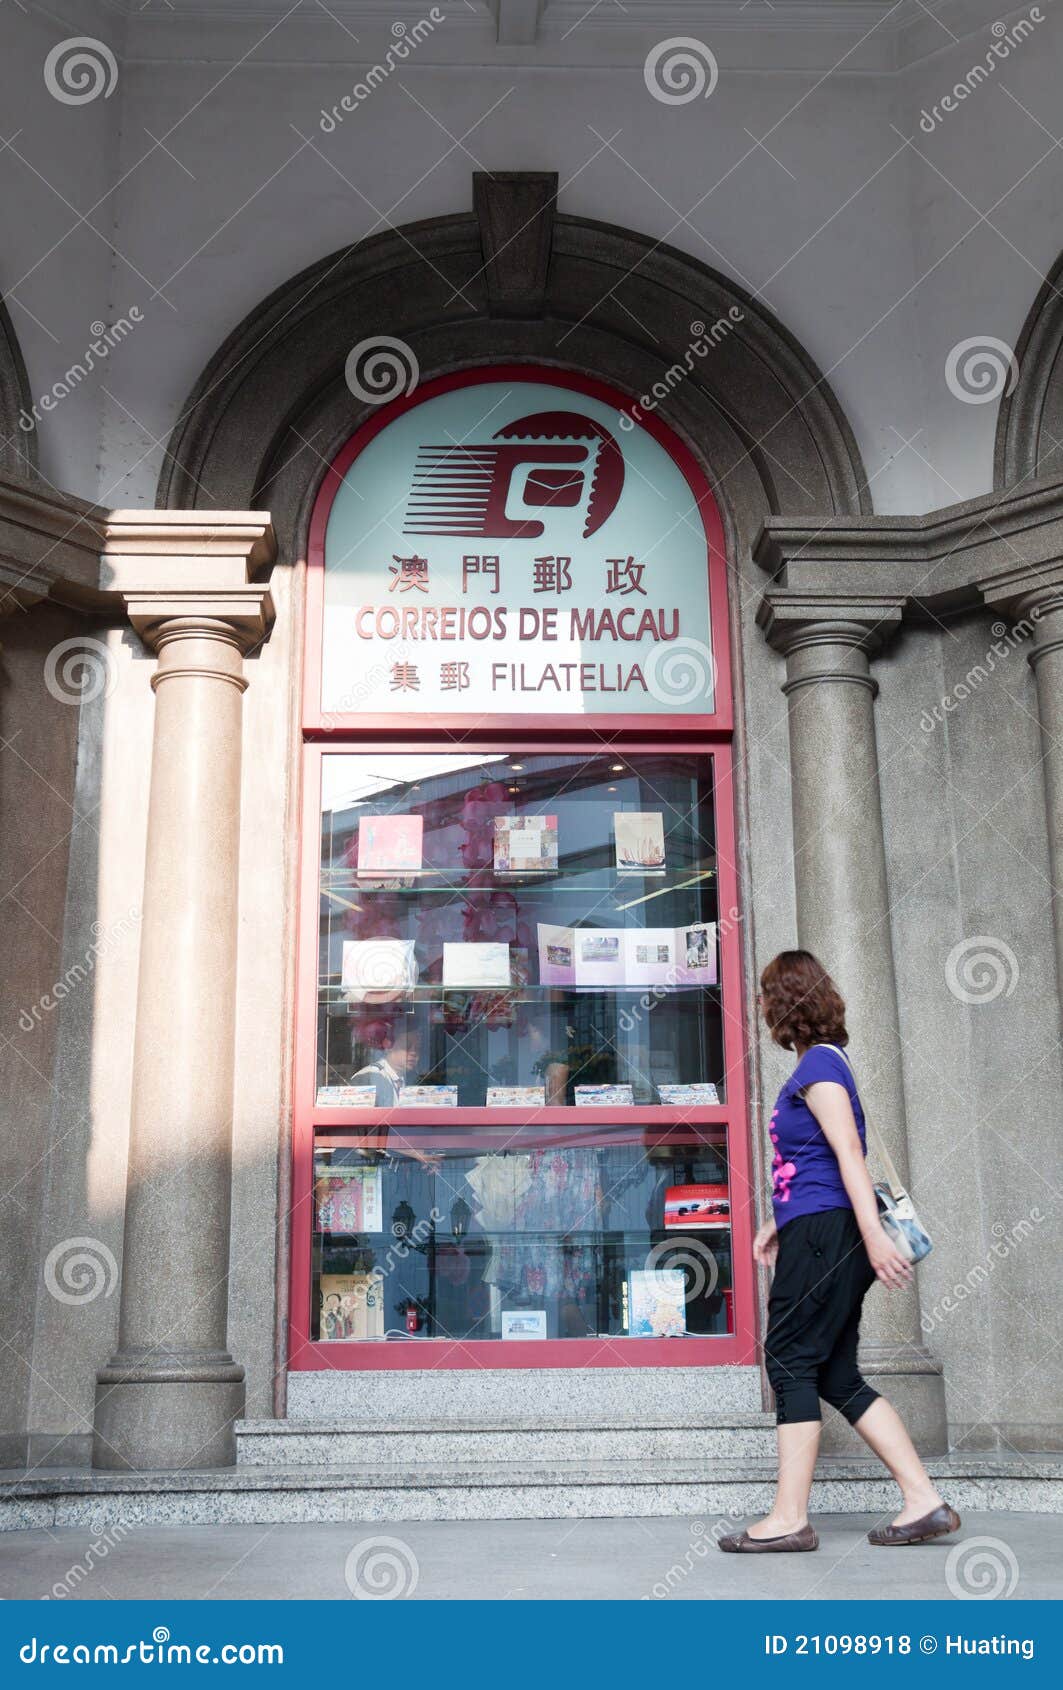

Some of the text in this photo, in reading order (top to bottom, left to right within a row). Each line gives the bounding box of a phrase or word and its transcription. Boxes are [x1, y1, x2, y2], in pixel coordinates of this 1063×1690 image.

[388, 555, 647, 595] 澳門郵政
[355, 605, 680, 641] CORREIOS DE MACAU
[389, 661, 649, 692] 集郵 FILATELIA
